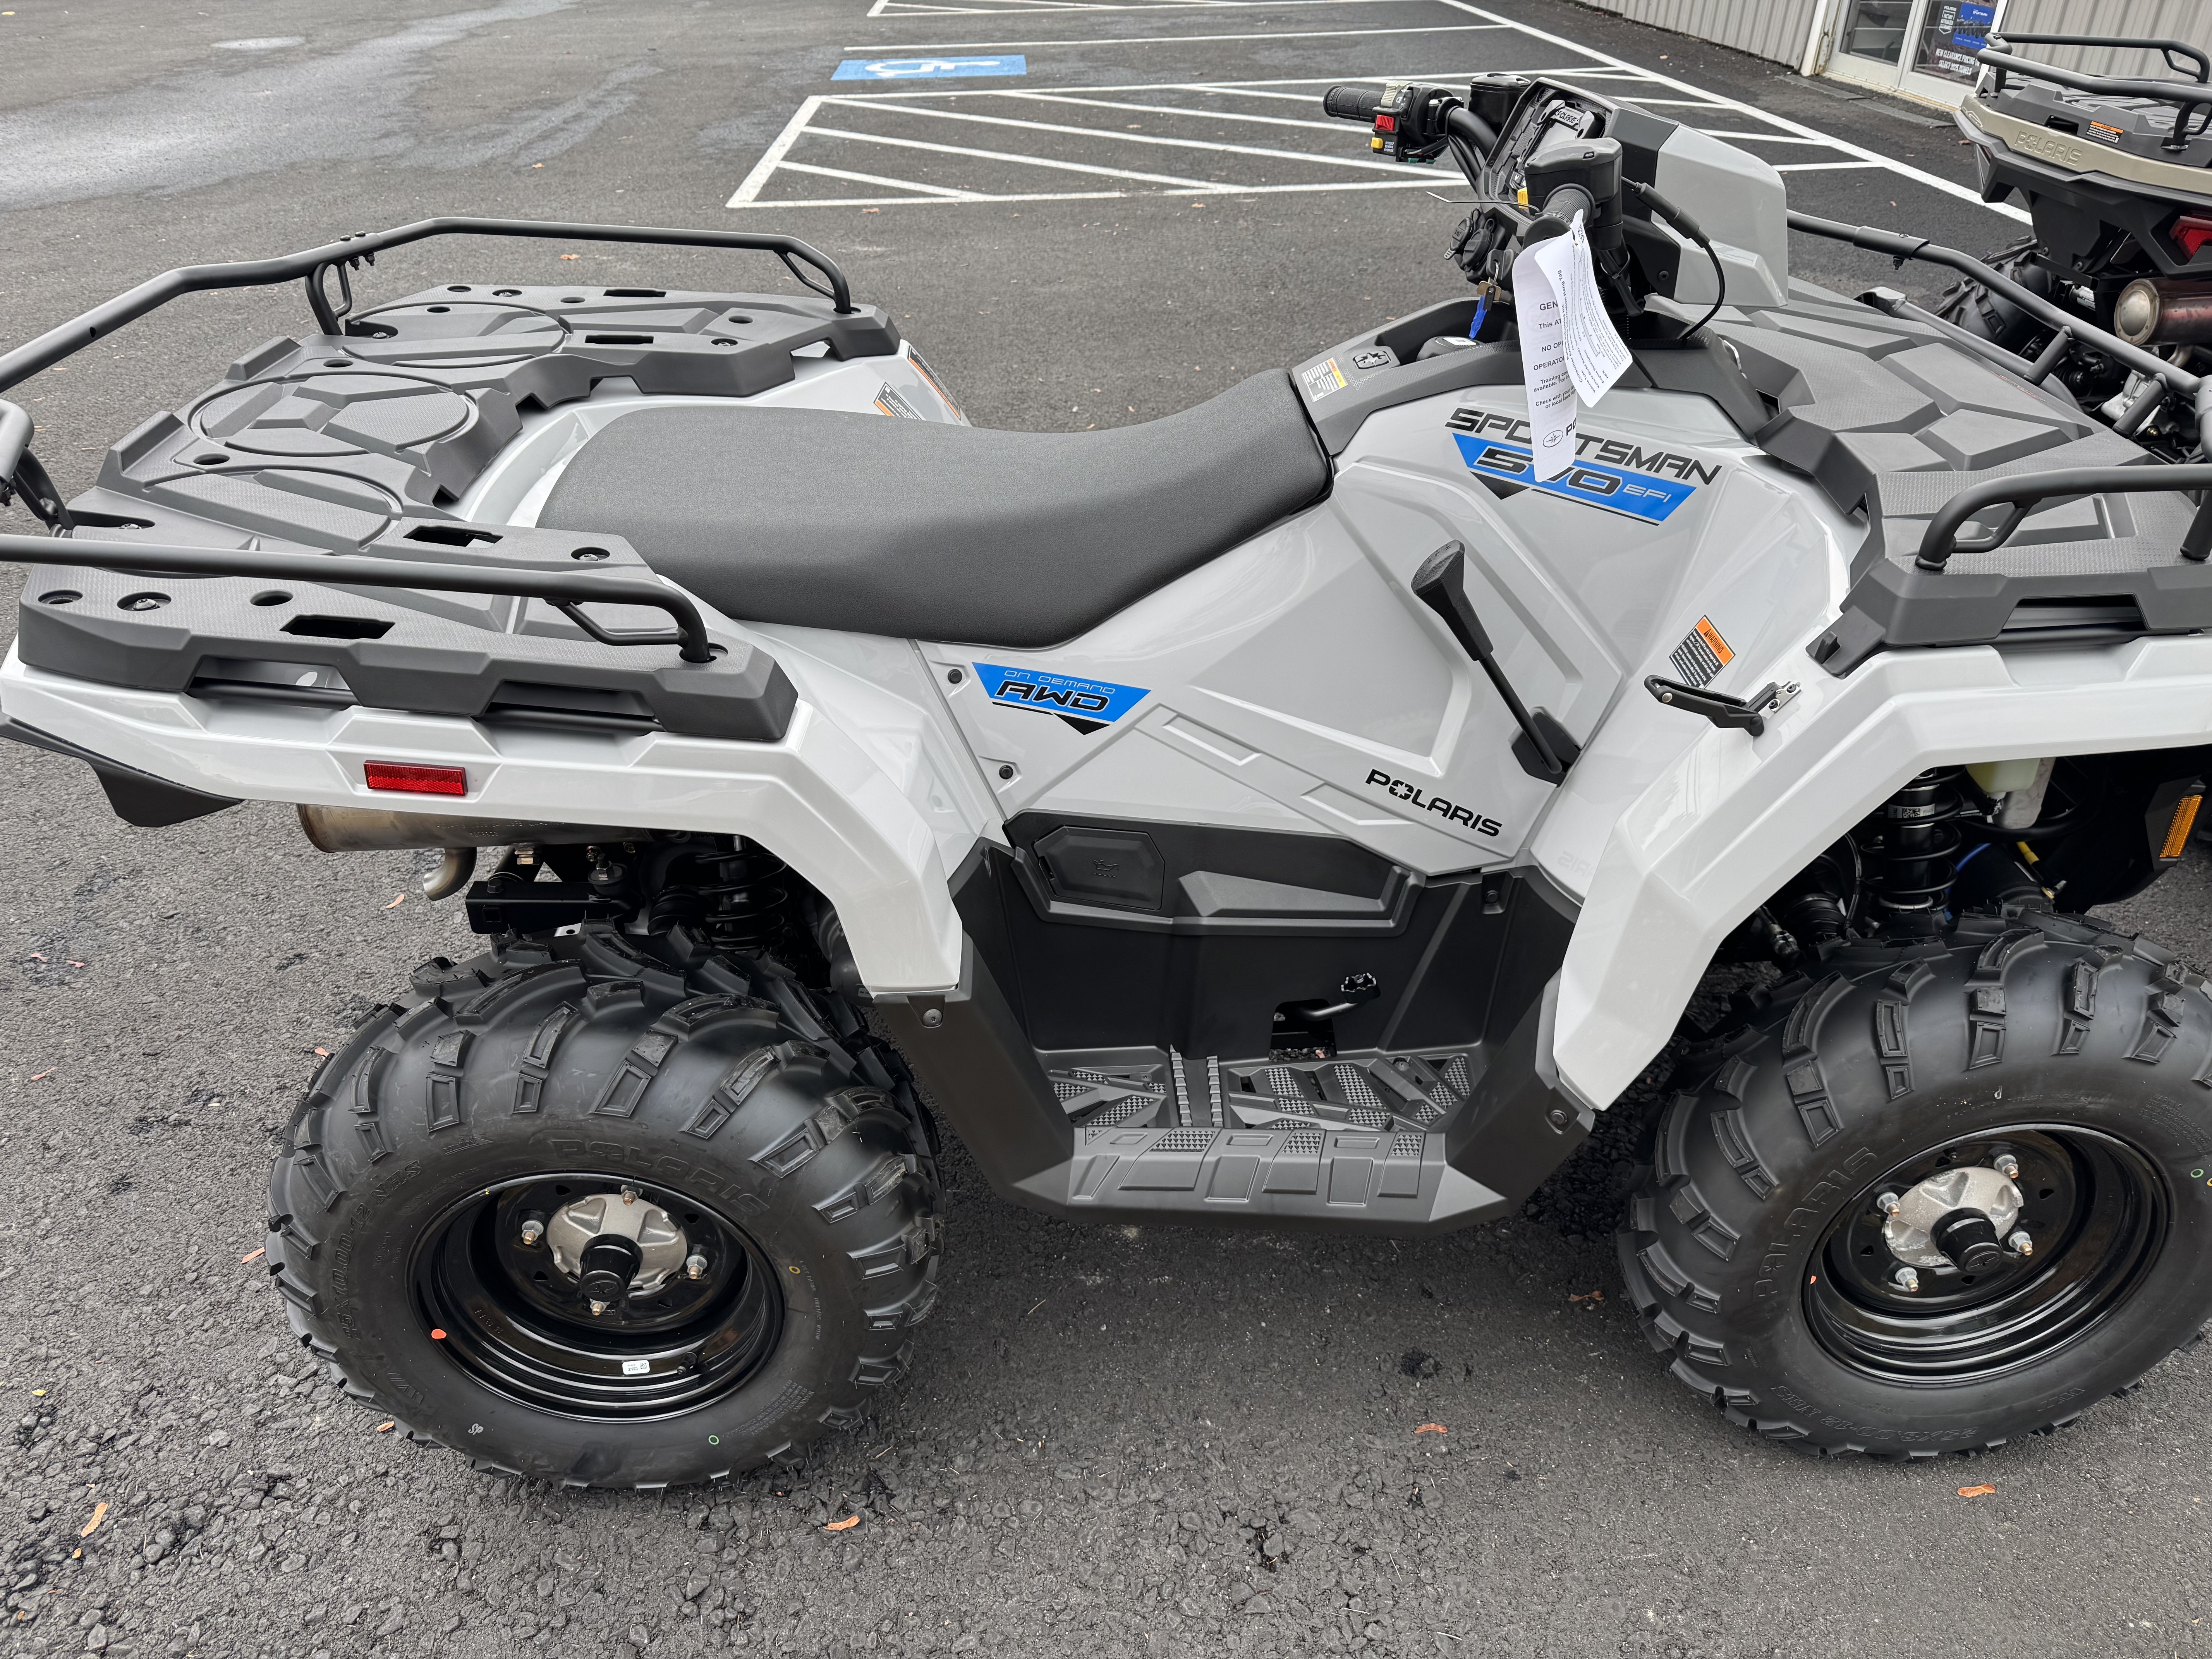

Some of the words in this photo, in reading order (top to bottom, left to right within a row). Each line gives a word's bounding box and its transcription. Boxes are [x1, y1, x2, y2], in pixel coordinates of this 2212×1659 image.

[1936, 48, 1944, 57] NEW
[1943, 50, 1962, 62] CLEARANCE
[1961, 55, 1975, 65] PRICING
[1939, 59, 1950, 70] SELECT
[1958, 65, 1972, 75] MODELS
[2014, 131, 2083, 166] POLARIS
[1540, 374, 1560, 384] Training
[1571, 357, 1583, 383] Consumer
[1534, 381, 1557, 392] available.
[1535, 398, 1551, 406] Check
[1552, 398, 1562, 407] local
[1445, 407, 1722, 485] SPOTSMAN
[1623, 484, 1671, 503] EFI
[1707, 632, 1724, 654] WARNING
[1004, 670, 1030, 679] ON
[1038, 675, 1116, 694] DEMAND
[994, 680, 1110, 713] AWD
[1365, 768, 1503, 837] POLARIS
[370, 1159, 422, 1204] NHS
[550, 1139, 771, 1216] POLARIS
[1753, 1147, 1877, 1302] POLARIS
[807, 1275, 817, 1292] RATING
[1771, 1386, 1821, 1417] NHS
[468, 1423, 484, 1436] SP
